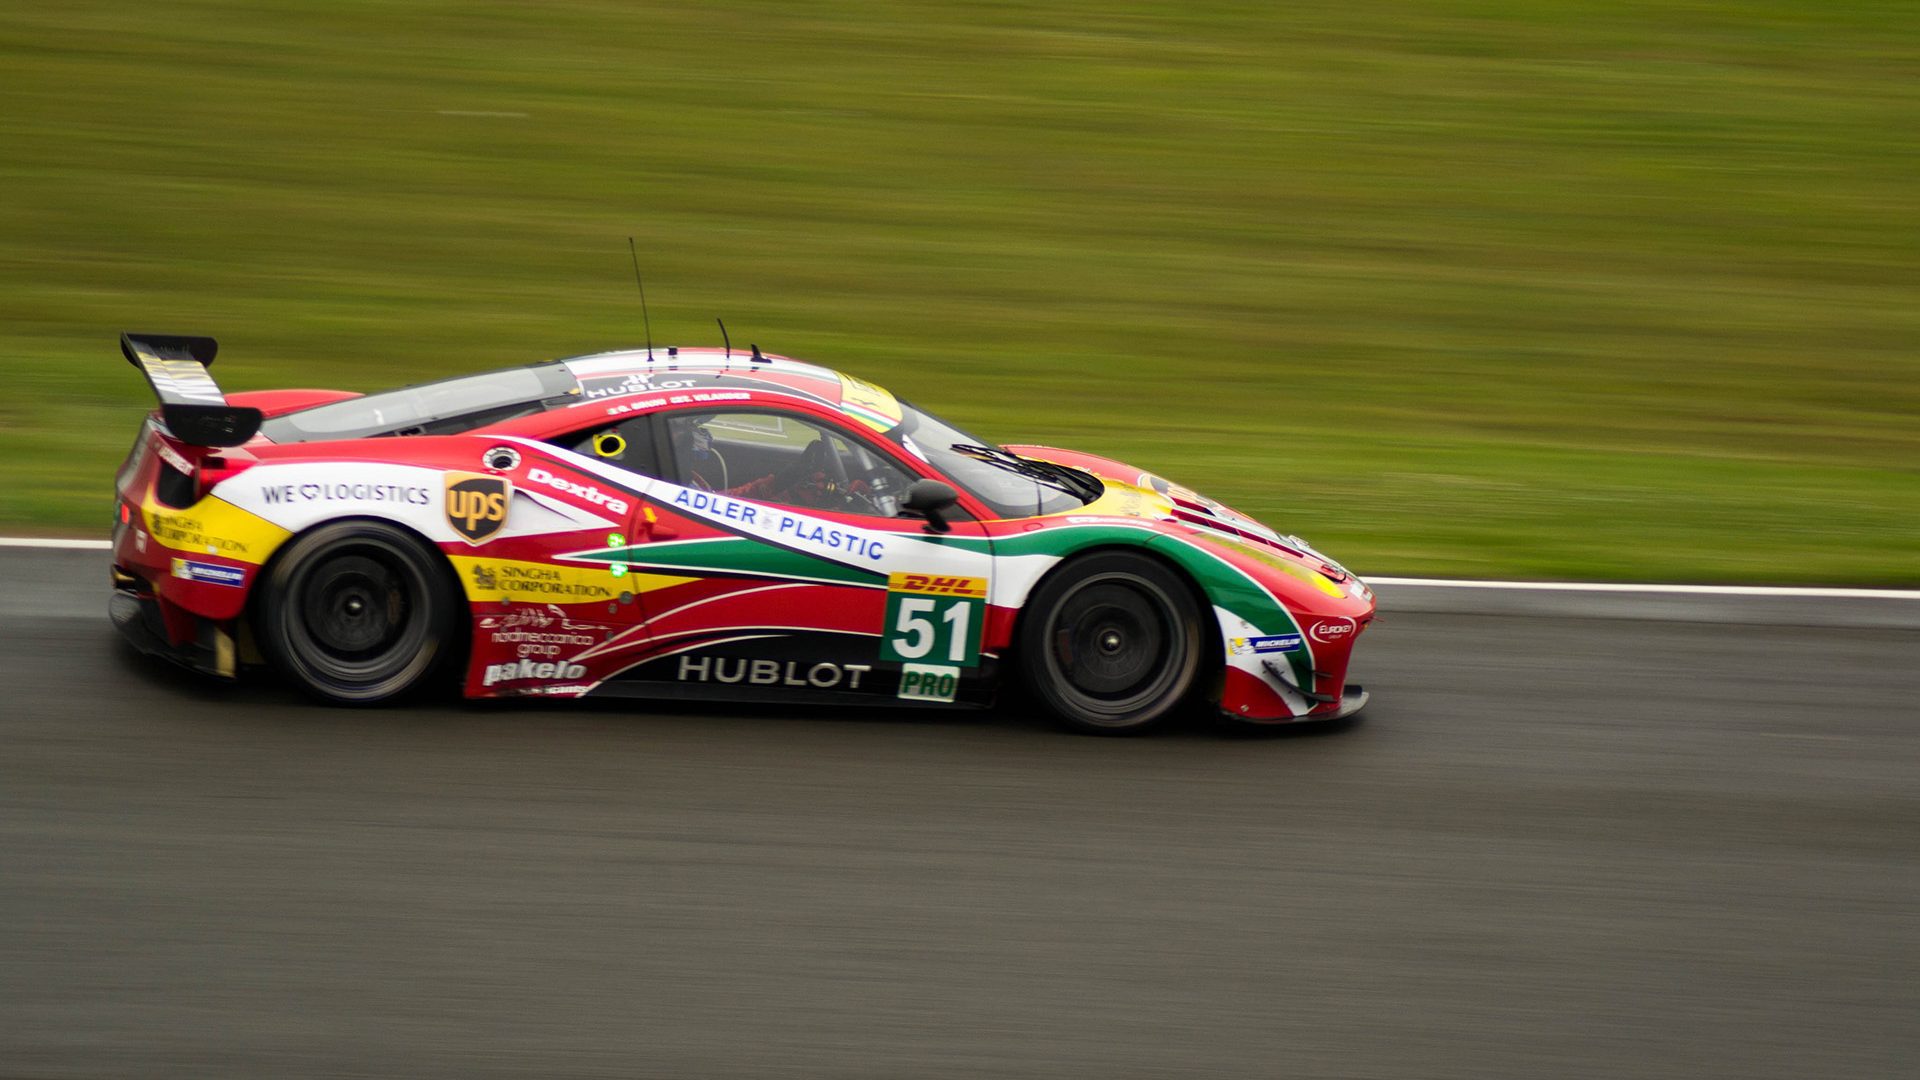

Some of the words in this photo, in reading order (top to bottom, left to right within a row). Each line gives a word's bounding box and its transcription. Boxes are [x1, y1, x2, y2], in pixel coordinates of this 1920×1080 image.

[587, 379, 697, 399] HUBLOT
[262, 485, 296, 504] WE
[324, 484, 431, 505] LOGISTICS
[526, 468, 629, 515] Dextra
[448, 489, 509, 531] ups
[675, 489, 757, 525] ADLER
[779, 517, 885, 562] PLASTIC
[502, 566, 562, 581] SINGHA
[902, 575, 974, 594] DHL
[500, 580, 612, 597] CORPORATION
[892, 598, 971, 661] 51
[516, 643, 561, 659] group
[482, 658, 588, 687] pakelo
[677, 655, 871, 689] HUBLOT
[902, 671, 957, 697] PRO
